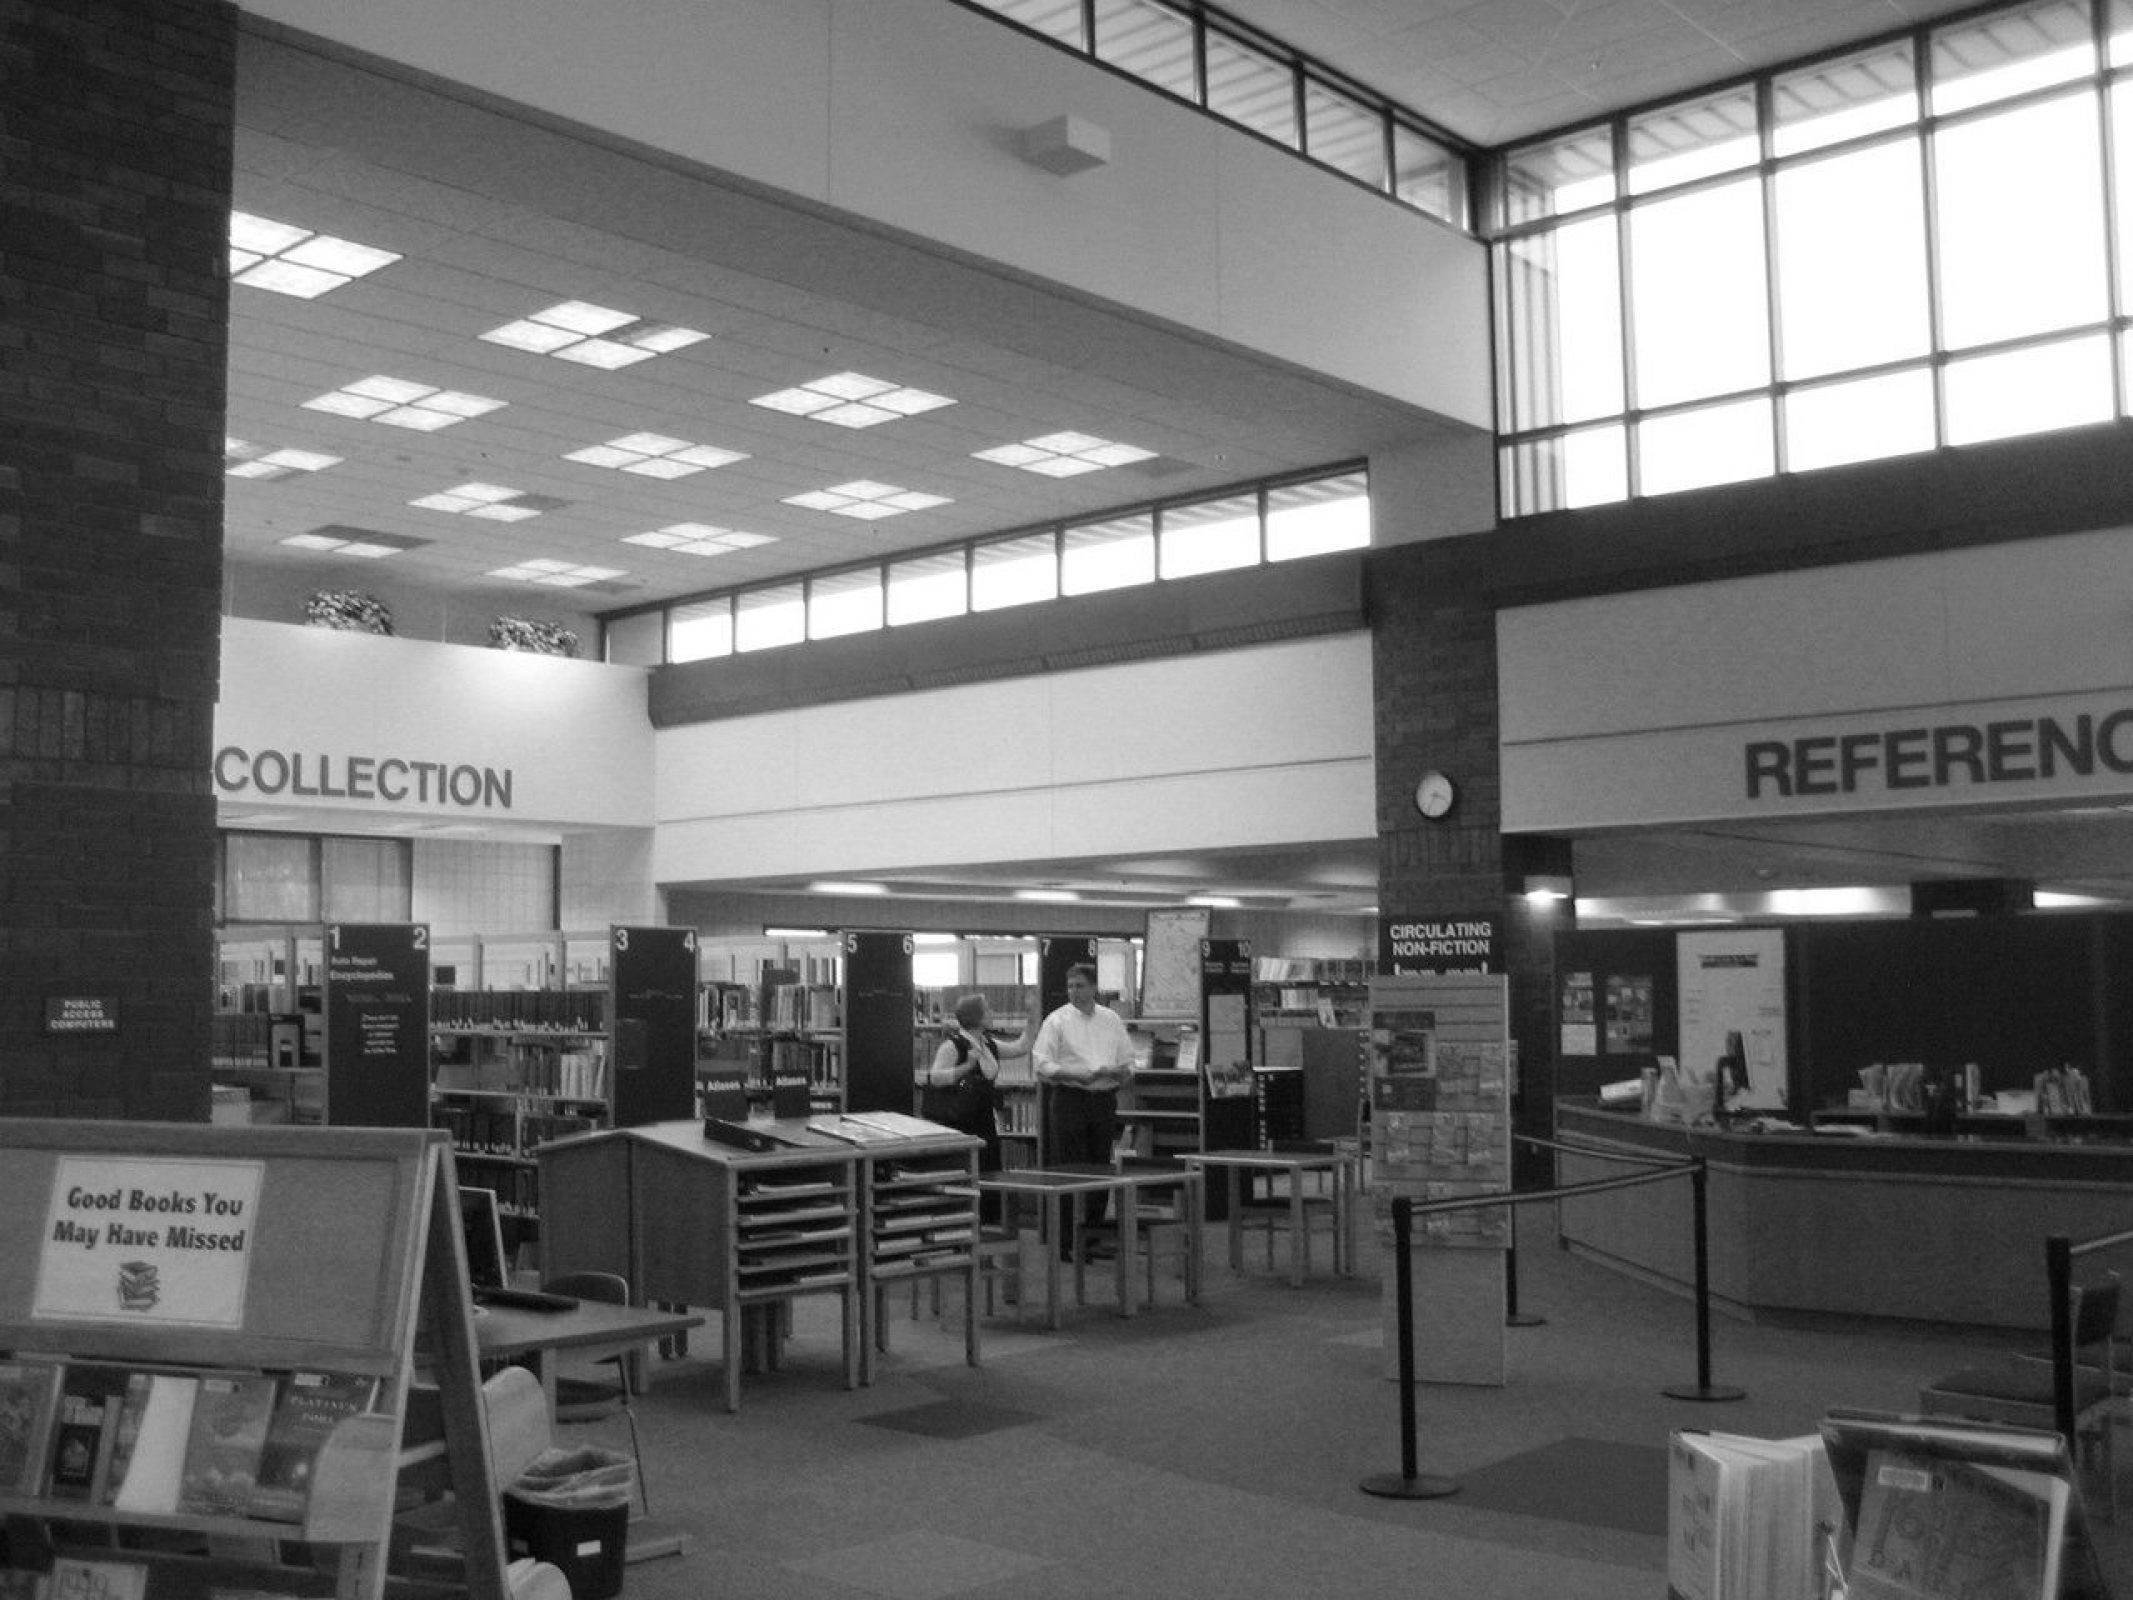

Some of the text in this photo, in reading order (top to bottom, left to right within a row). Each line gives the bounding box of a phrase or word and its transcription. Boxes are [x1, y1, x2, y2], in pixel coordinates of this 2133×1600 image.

[1744, 709, 2133, 799] REFERENC
[214, 746, 513, 809] COLLECTION
[329, 925, 341, 950] 1
[412, 926, 427, 951] 2
[615, 929, 629, 951] 3
[1390, 921, 1492, 940] CIRCULATING
[684, 931, 696, 953] 4
[847, 932, 858, 954] 5
[902, 934, 913, 955] 6
[1042, 938, 1052, 957] 7
[1238, 940, 1251, 959] 10
[1392, 939, 1491, 956] NON-FICTION
[67, 1186, 244, 1216] Good Books You
[53, 1219, 246, 1252] May Have Missed
